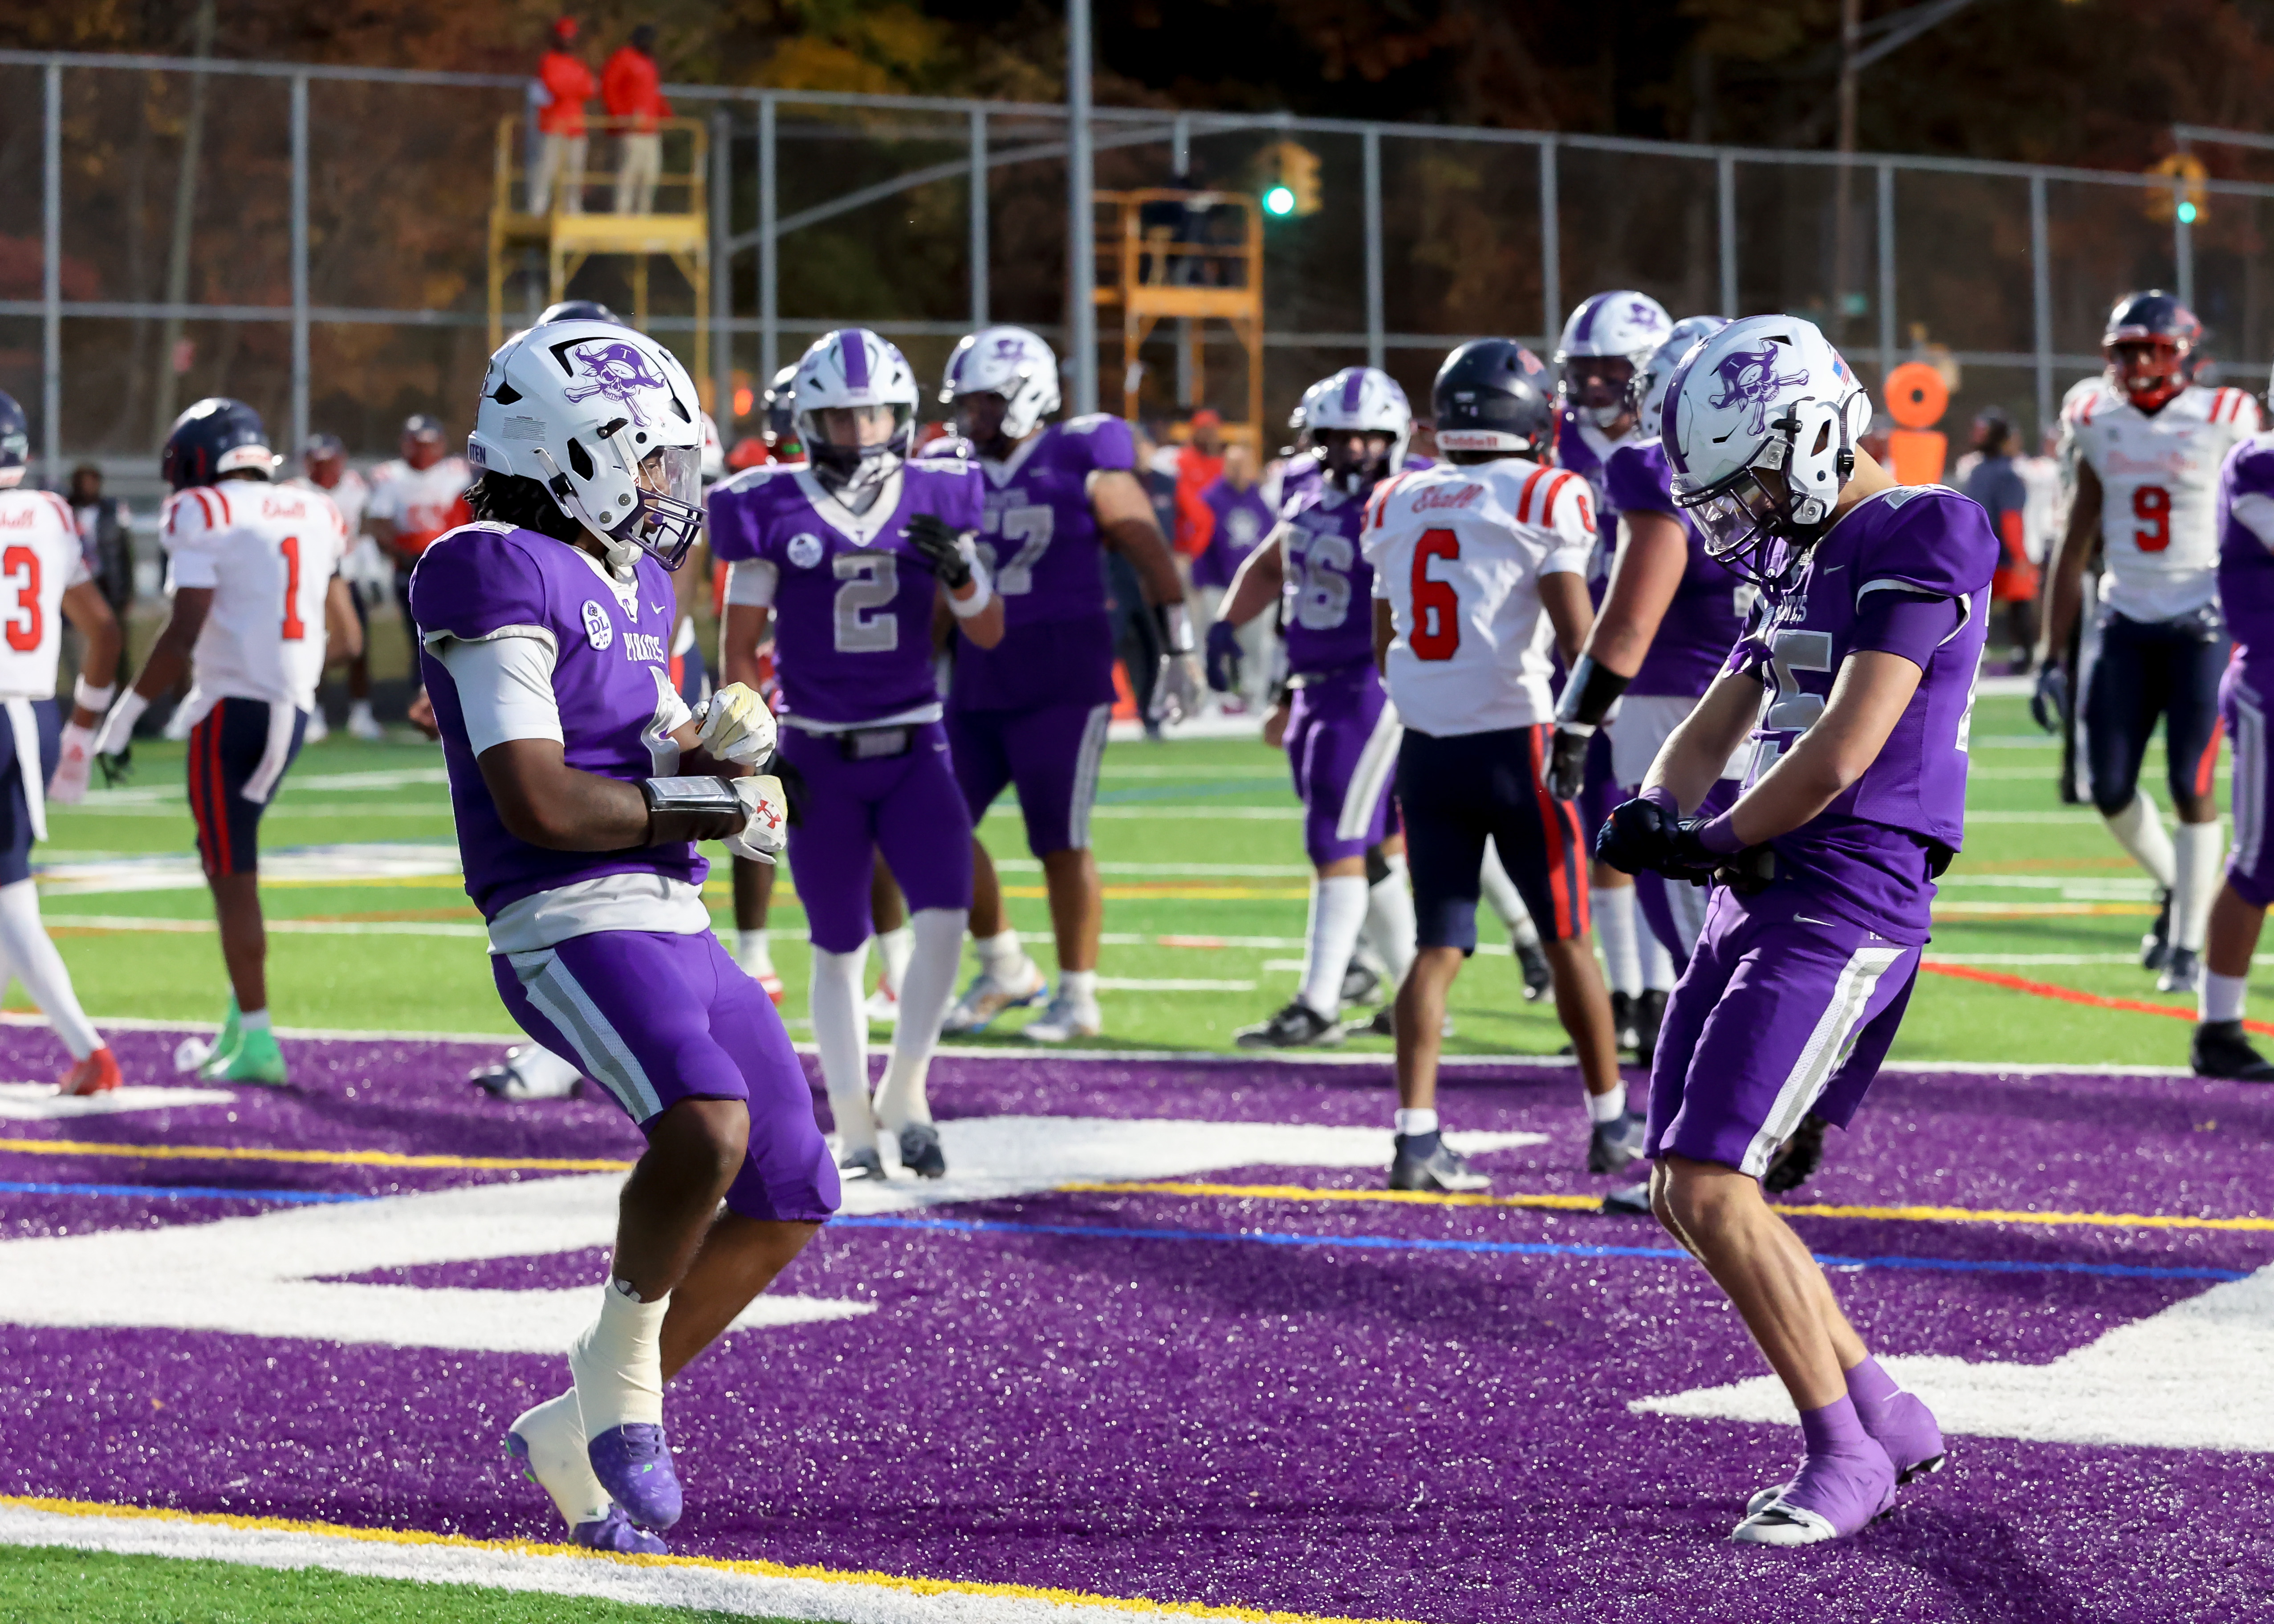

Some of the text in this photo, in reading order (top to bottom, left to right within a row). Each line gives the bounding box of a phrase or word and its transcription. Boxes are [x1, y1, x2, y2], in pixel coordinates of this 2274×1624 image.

[620, 348, 632, 359] T
[1726, 358, 1740, 369] T
[2132, 486, 2172, 553] 9
[3, 546, 42, 652] 3
[281, 536, 305, 640] 1
[622, 598, 635, 618] T
[832, 551, 899, 653] 2
[1409, 528, 1459, 660] 6
[588, 616, 609, 635] DL
